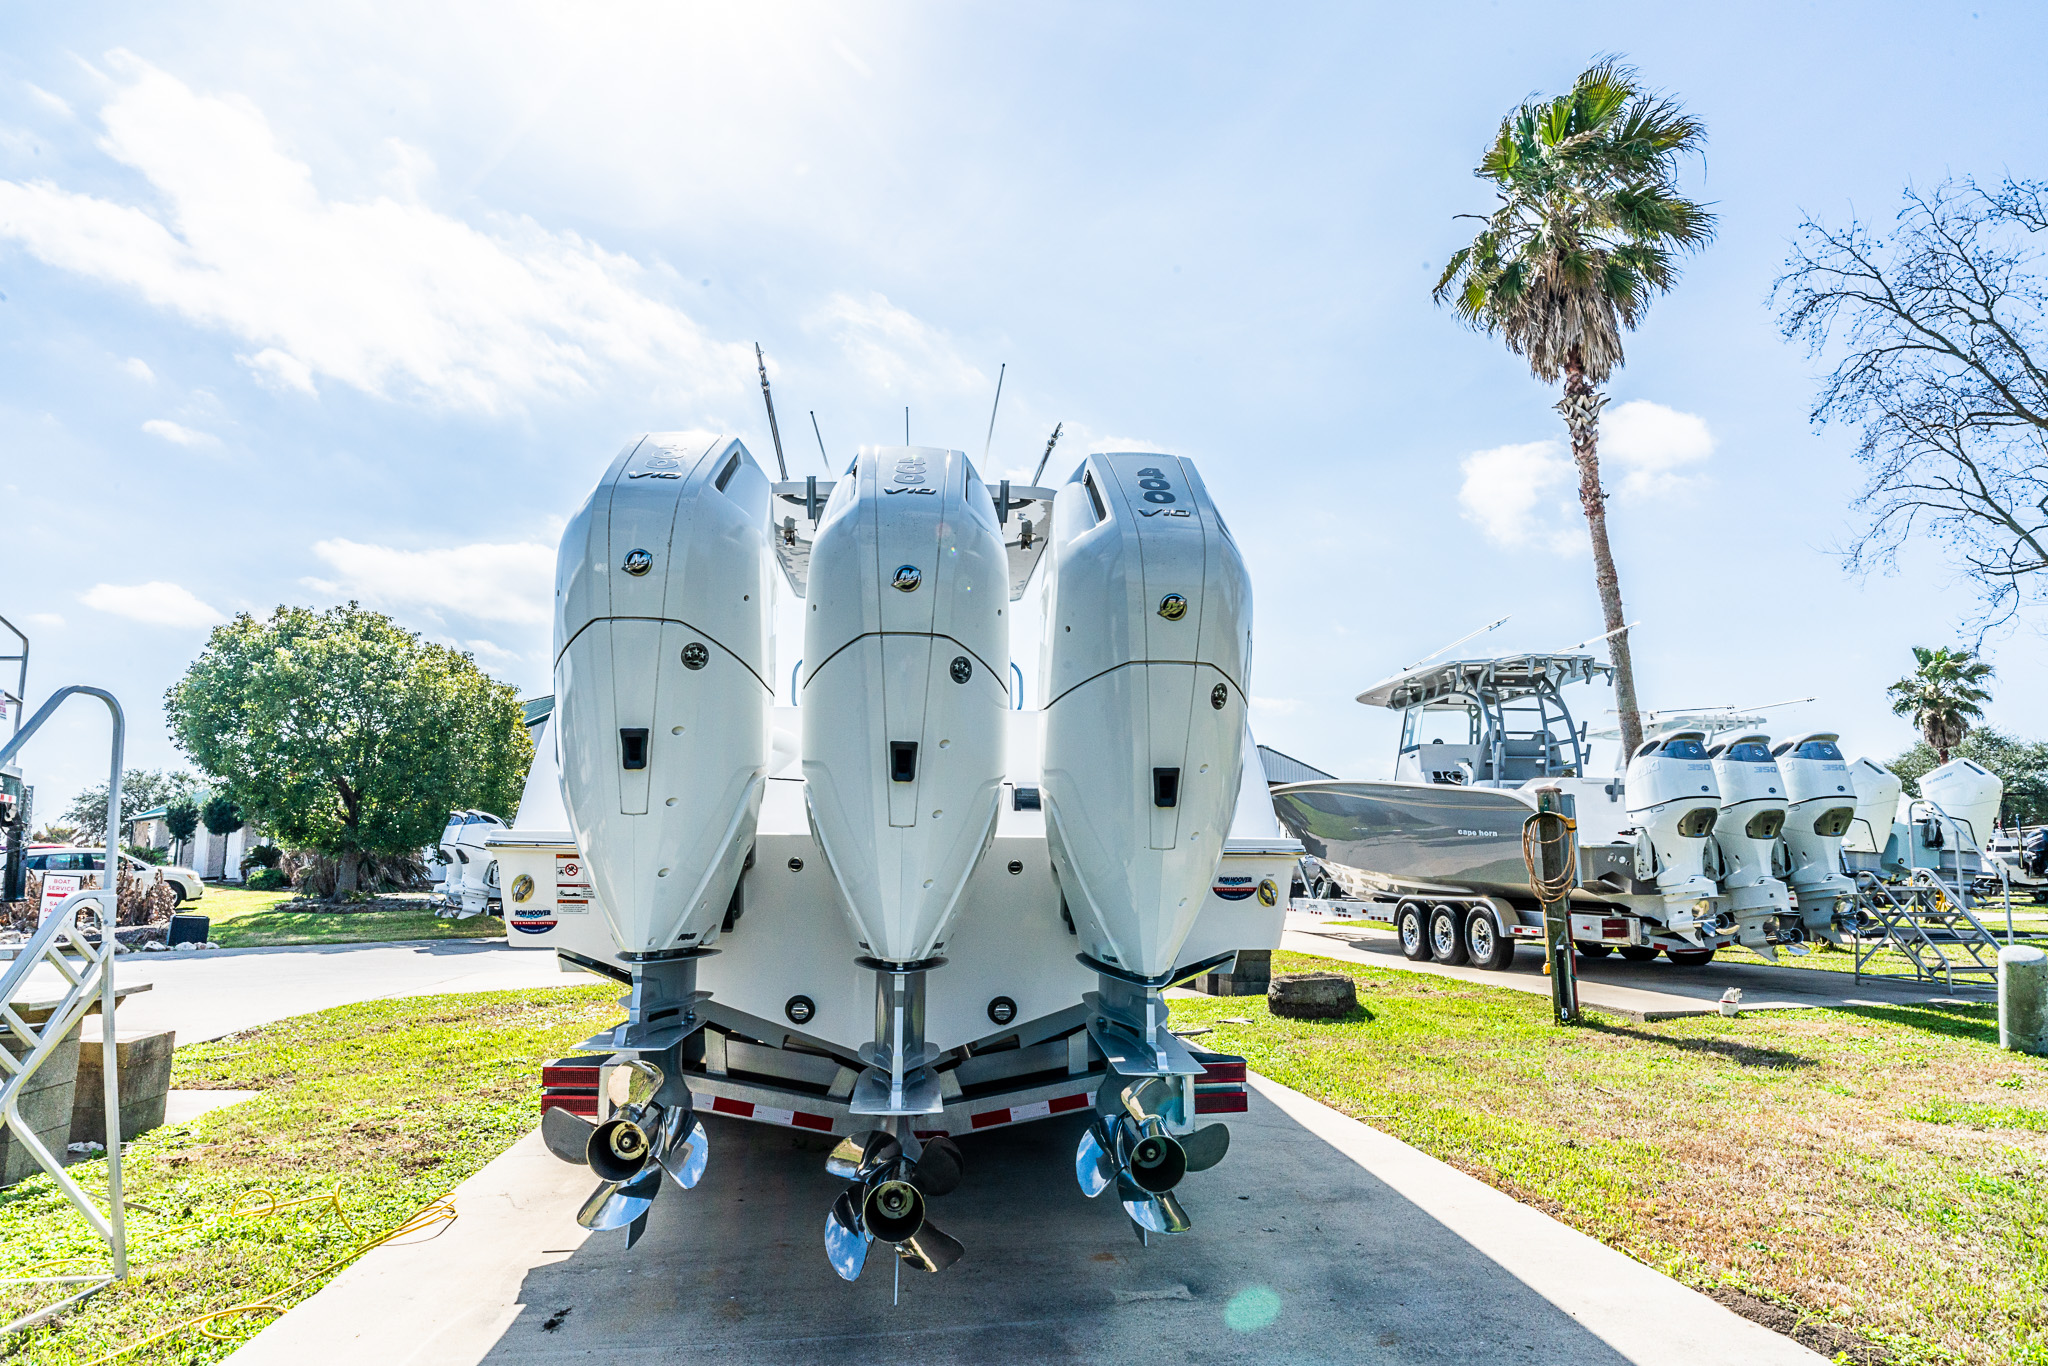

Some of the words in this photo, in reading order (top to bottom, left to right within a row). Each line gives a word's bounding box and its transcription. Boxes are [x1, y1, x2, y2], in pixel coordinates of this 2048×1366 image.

[893, 456, 926, 484] 400
[628, 471, 682, 480] V10
[1137, 467, 1176, 504] 400
[883, 487, 936, 495] V10
[1138, 508, 1191, 518] V10
[1478, 829, 1498, 837] horn
